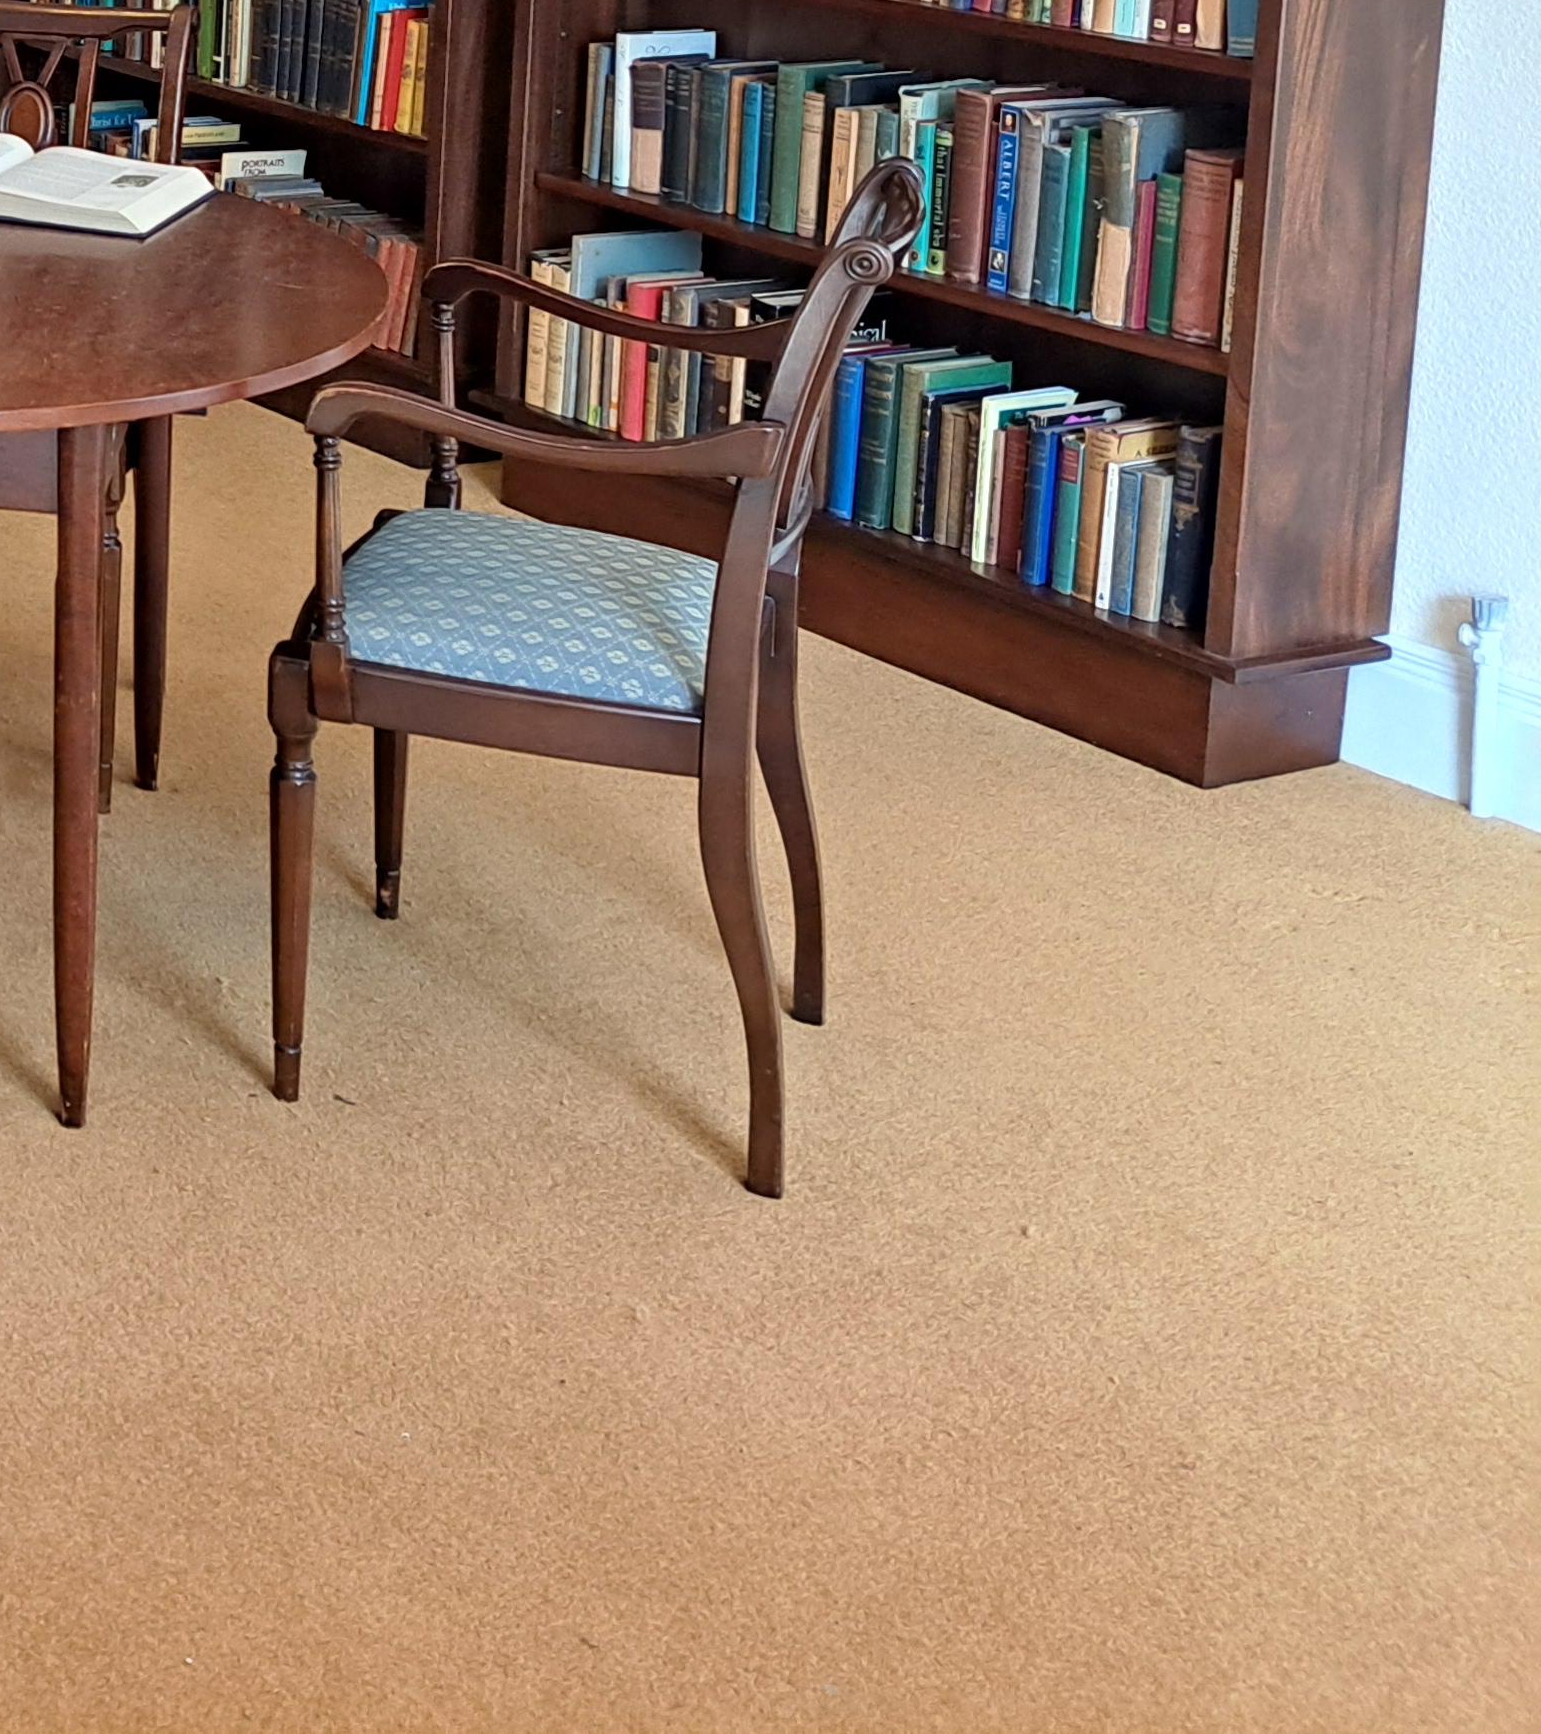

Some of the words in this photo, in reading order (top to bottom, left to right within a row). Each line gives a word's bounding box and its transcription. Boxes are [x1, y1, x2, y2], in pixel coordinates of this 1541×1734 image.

[241, 158, 286, 170] PORTRAITS
[935, 145, 949, 171] that
[998, 138, 1014, 202] ALBERT
